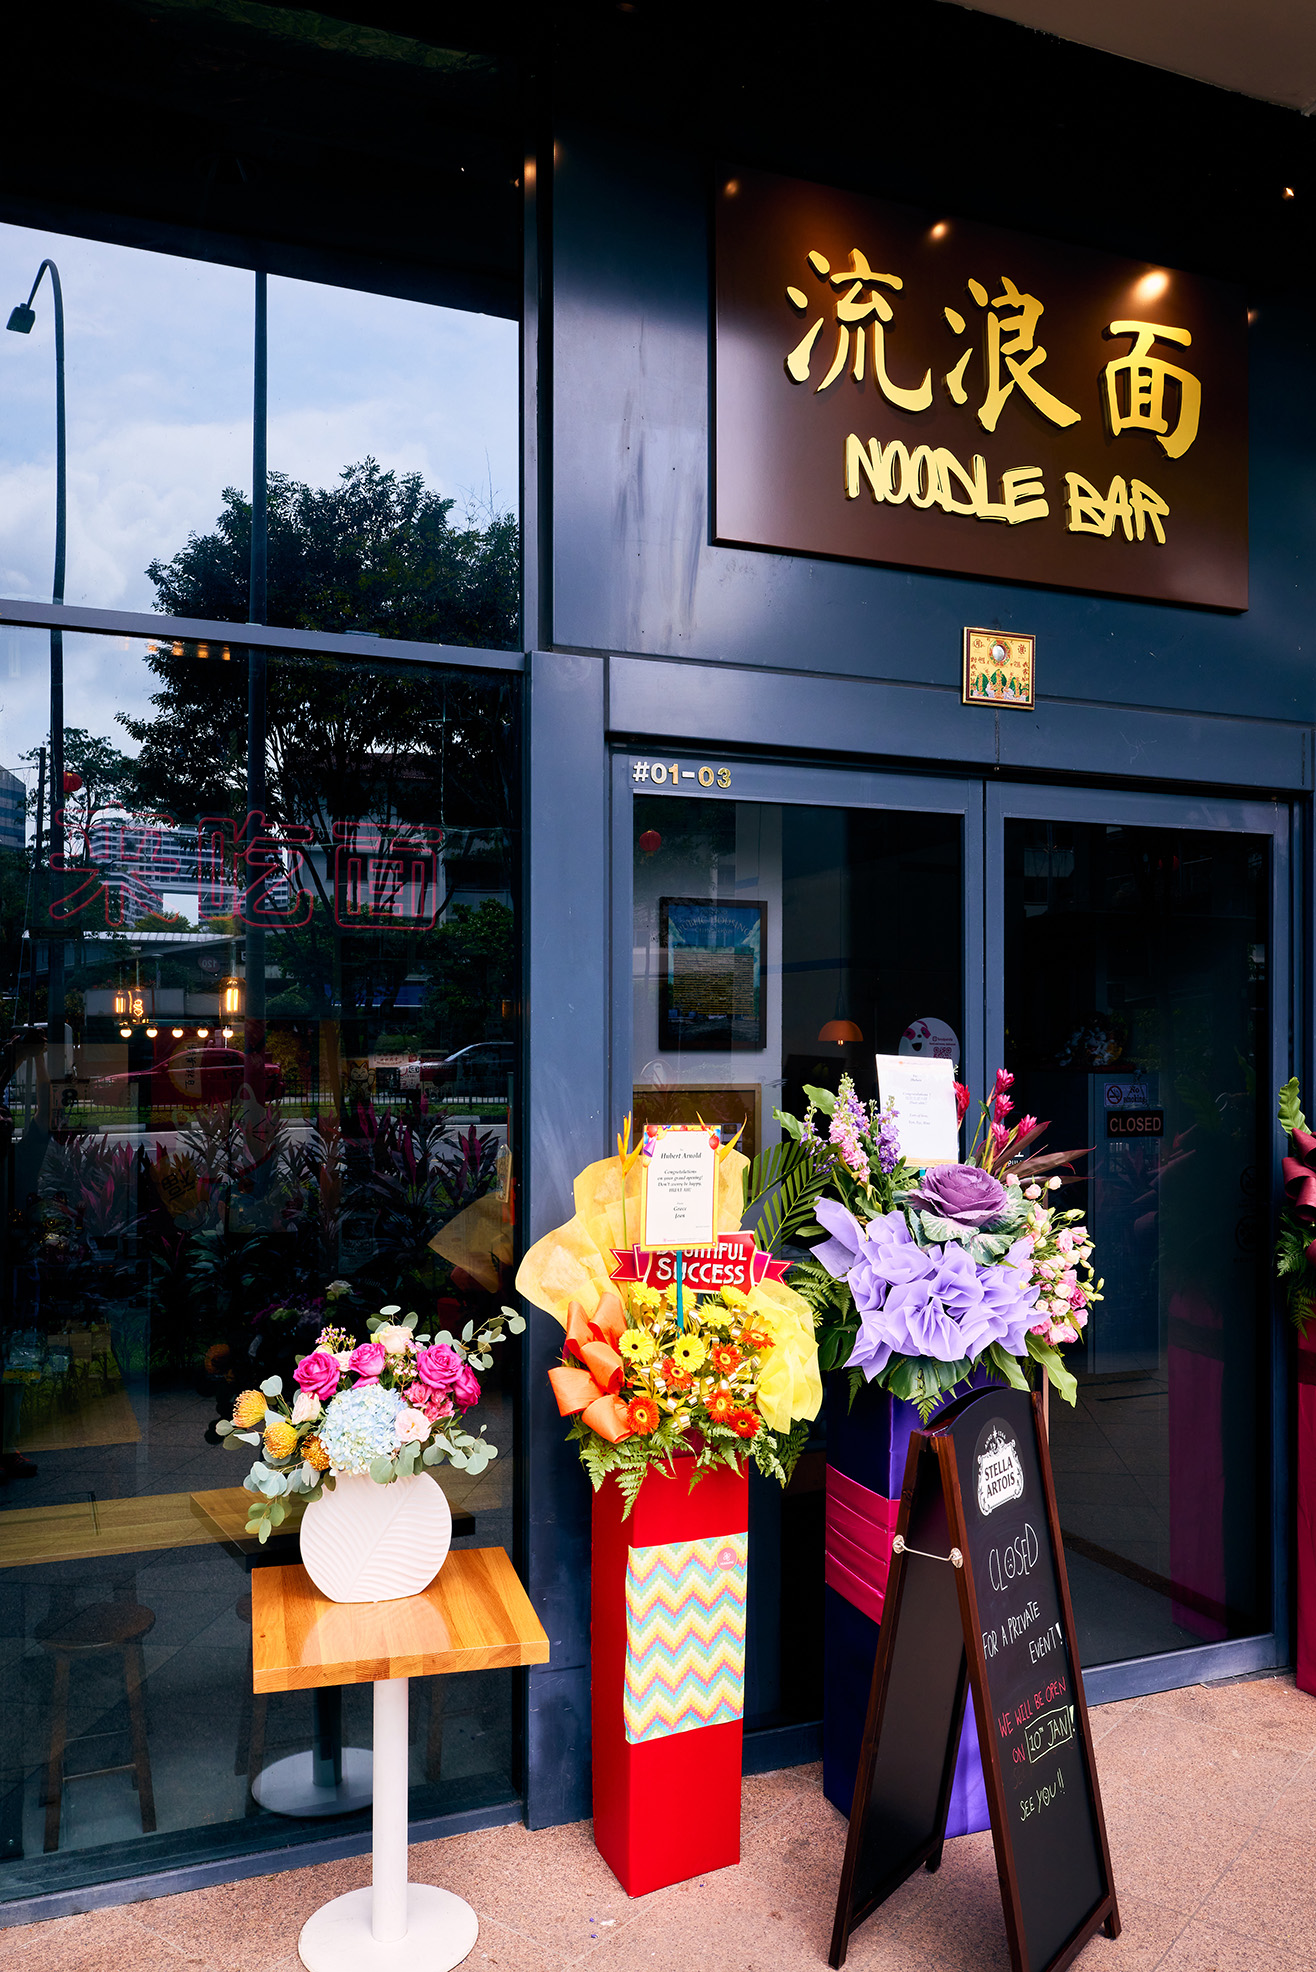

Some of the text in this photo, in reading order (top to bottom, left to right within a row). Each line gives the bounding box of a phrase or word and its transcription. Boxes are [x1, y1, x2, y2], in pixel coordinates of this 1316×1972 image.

[786, 247, 1201, 459] 流浪面
[845, 433, 1170, 544] NOODLE BAR
[632, 760, 732, 789] #01-03
[1109, 1116, 1162, 1133] CLOSED
[656, 1257, 745, 1285] SUCCESS
[984, 1456, 1014, 1481] STELLA
[986, 1471, 1015, 1498] ARTOIS
[988, 1522, 1039, 1591] CLOSED
[982, 1601, 1041, 1660] FOR A PRIVATE
[997, 1676, 1067, 1738] WE WILL BE OPEN
[1012, 1743, 1026, 1764] ON
[1019, 1796, 1036, 1822] SEE
